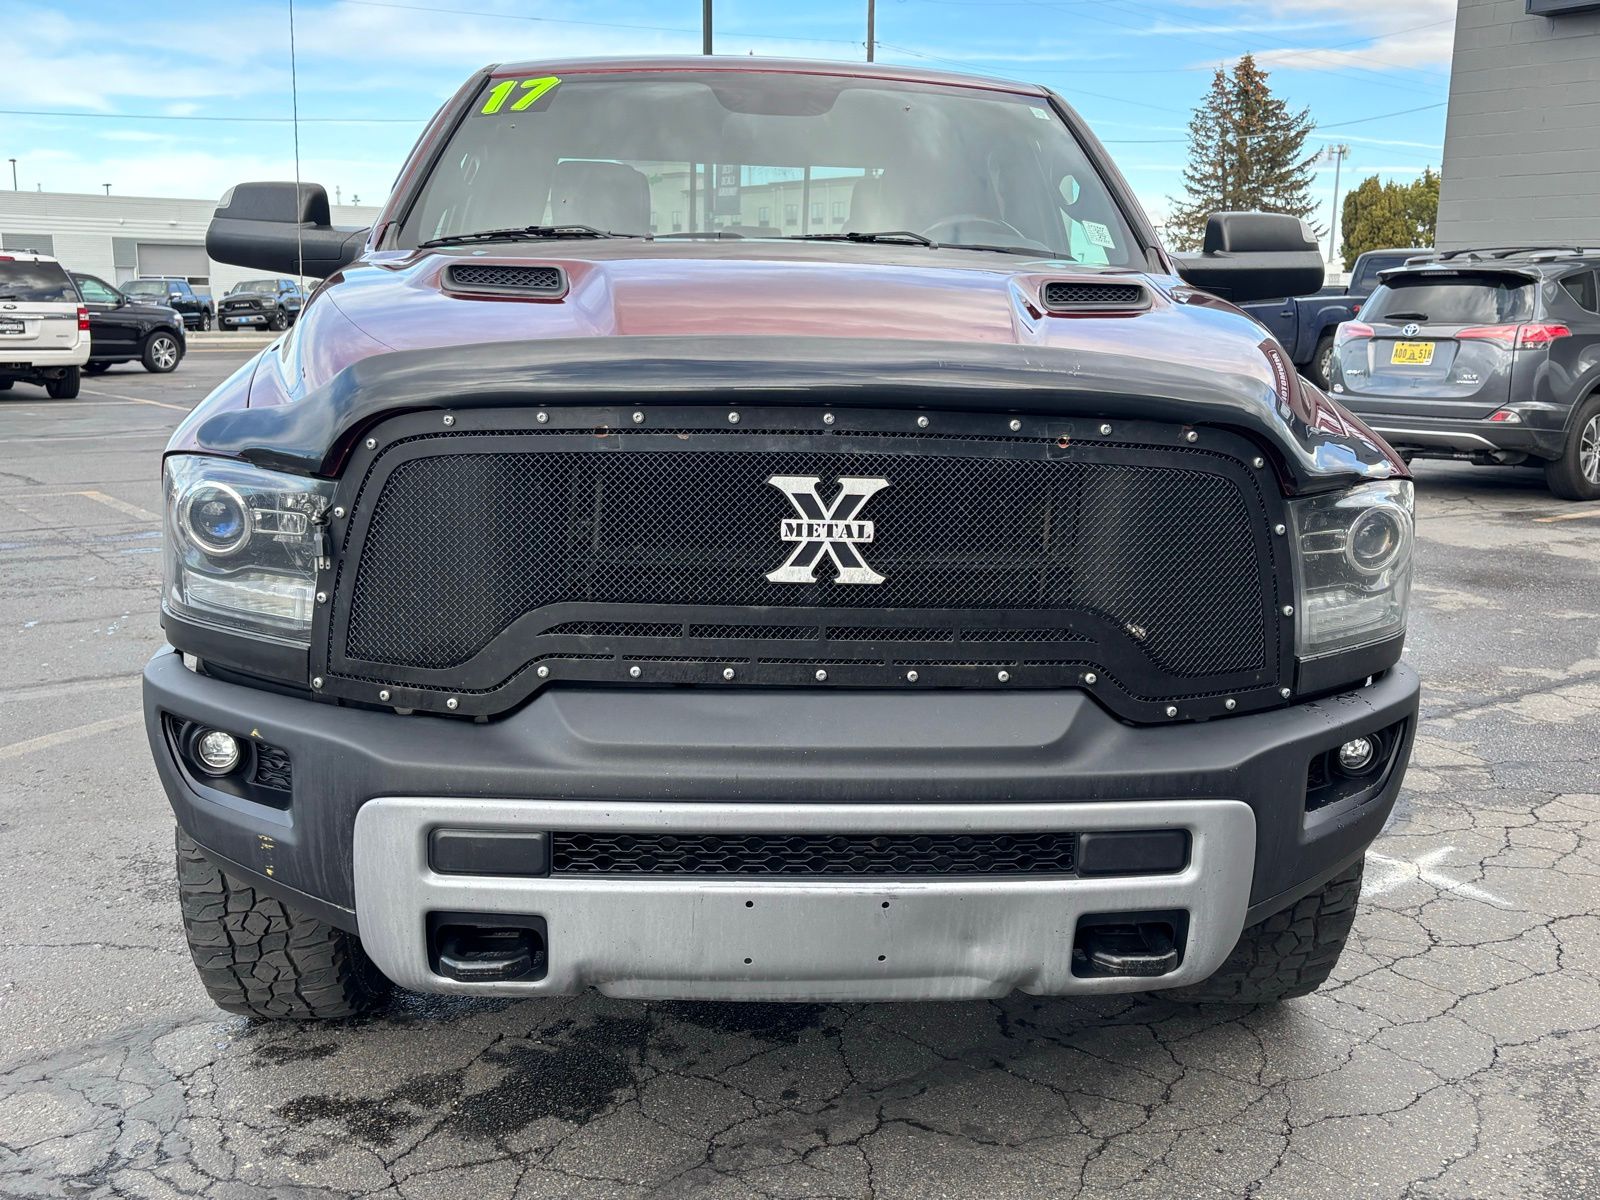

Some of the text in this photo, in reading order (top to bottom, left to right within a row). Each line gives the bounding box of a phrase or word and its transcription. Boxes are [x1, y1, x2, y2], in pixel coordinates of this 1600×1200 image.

[481, 76, 561, 114] 17
[766, 476, 890, 584] X
[784, 522, 872, 539] METAL
